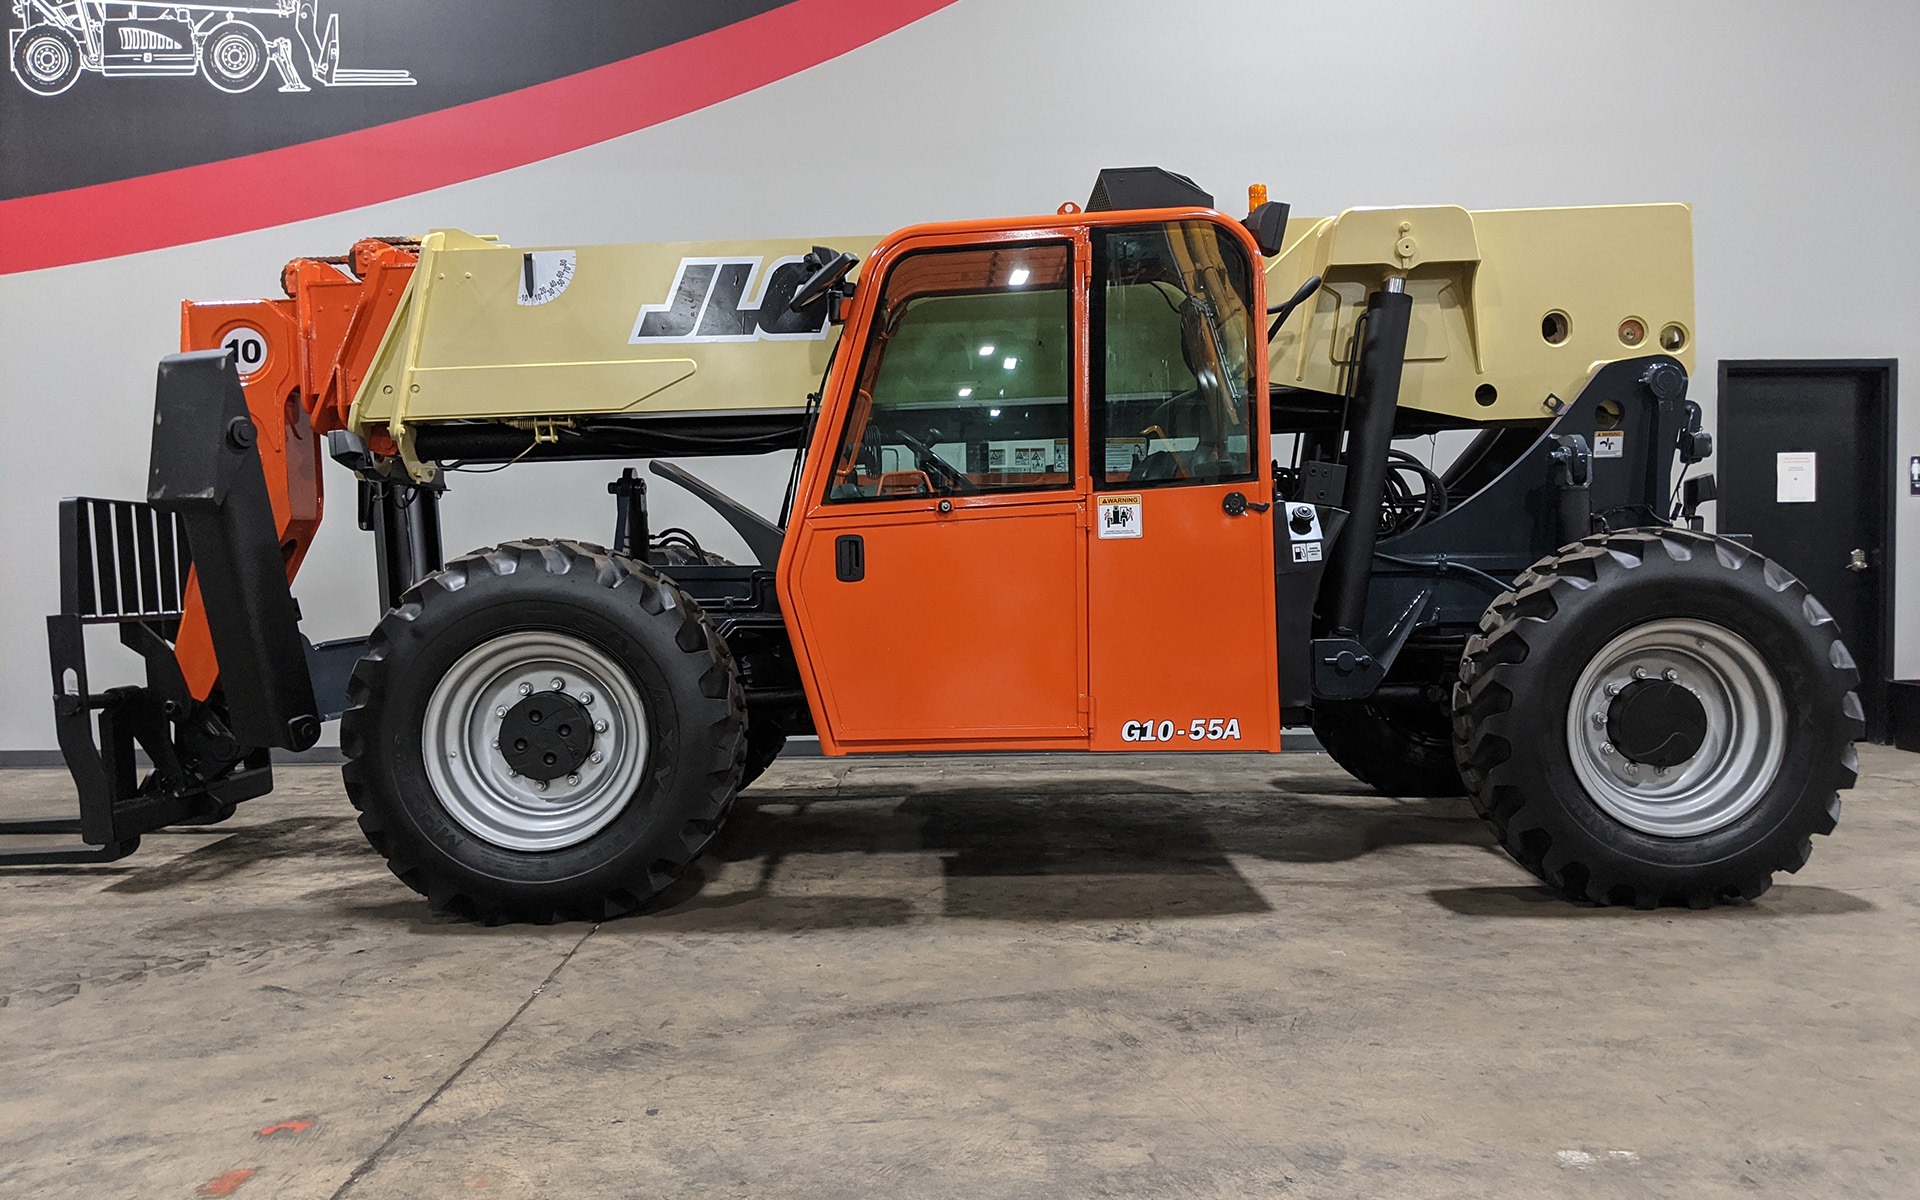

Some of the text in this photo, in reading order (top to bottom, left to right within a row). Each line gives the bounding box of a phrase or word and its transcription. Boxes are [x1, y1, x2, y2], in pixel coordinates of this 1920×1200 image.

[560, 259, 567, 267] 80
[563, 266, 571, 274] 70
[549, 280, 557, 288] 40
[557, 278, 565, 287] 50
[539, 286, 547, 295] 20
[547, 287, 555, 296] 30
[534, 293, 542, 301] 10
[629, 255, 846, 344] JLG
[225, 338, 262, 364] 10
